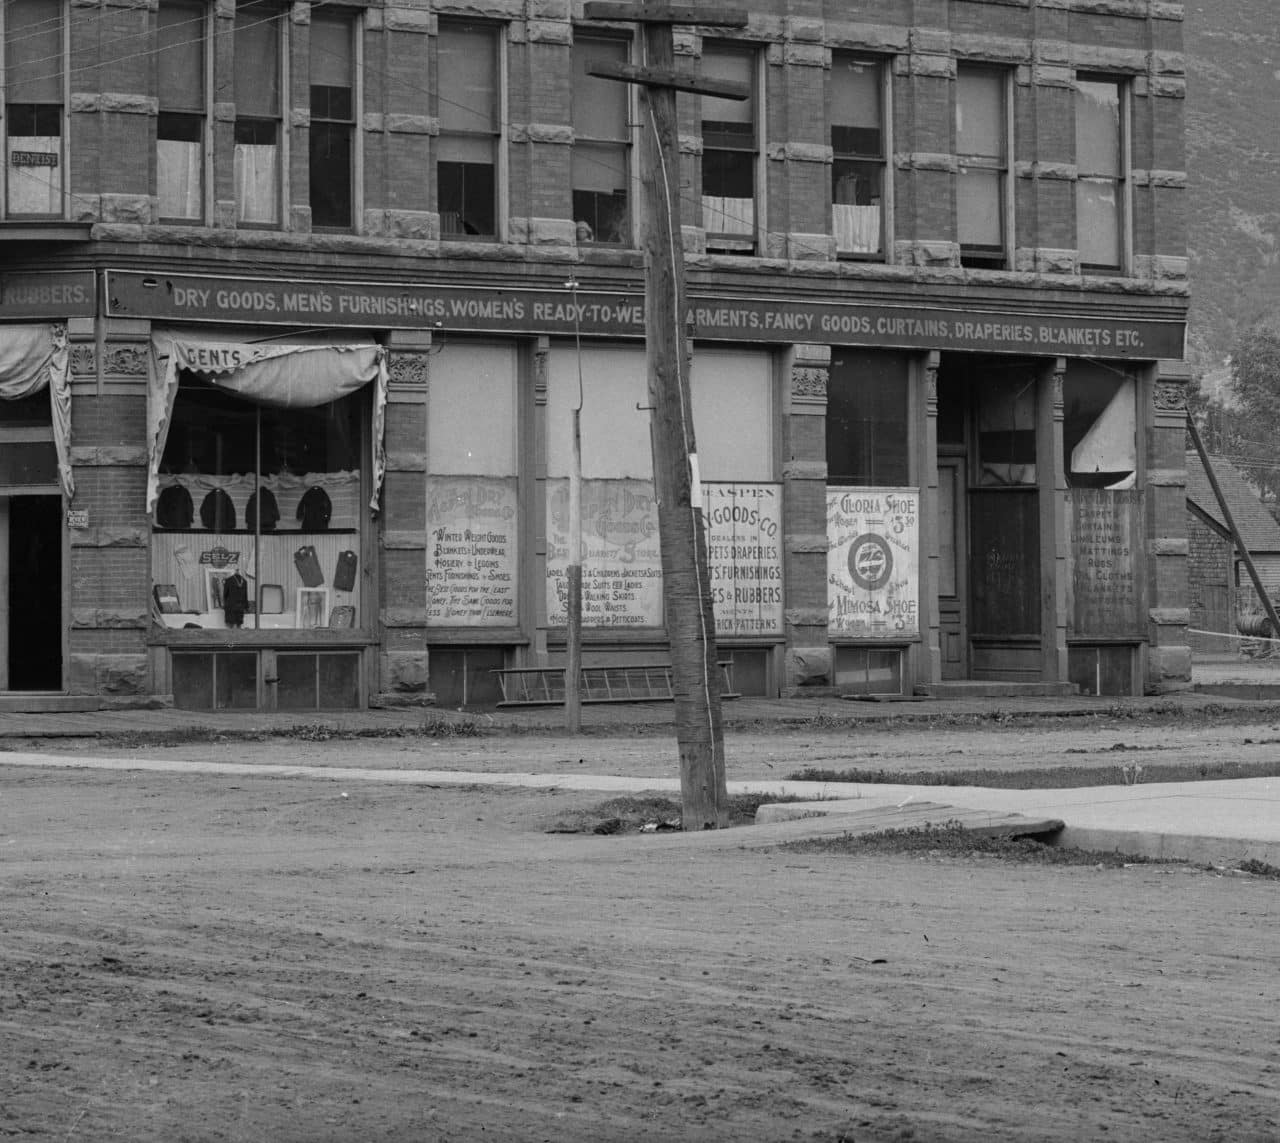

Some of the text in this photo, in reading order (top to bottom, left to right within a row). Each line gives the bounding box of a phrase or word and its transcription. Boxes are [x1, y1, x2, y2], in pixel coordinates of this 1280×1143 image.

[12, 153, 58, 166] DENTIST
[4, 284, 90, 305] RUBBERS.
[174, 288, 1145, 348] DRY GOODS, MEN'S FURNISHINGS, WOMEN'S READY-TO-WE ARMENTS, FANCY GOODS, CURTAINS, DRAPERIES, BLANKETS ETC.
[187, 347, 241, 366] GENTS
[840, 493, 881, 514] GLORIA
[883, 494, 916, 515] SHOE
[713, 505, 760, 526] GOODS
[487, 531, 508, 544] GOODS
[202, 553, 238, 563] SELZ
[709, 546, 729, 560] PETS
[434, 558, 464, 569] HOSIERY
[726, 591, 733, 600] &
[883, 599, 917, 616] SHOE
[737, 619, 777, 630] PATTERNS
